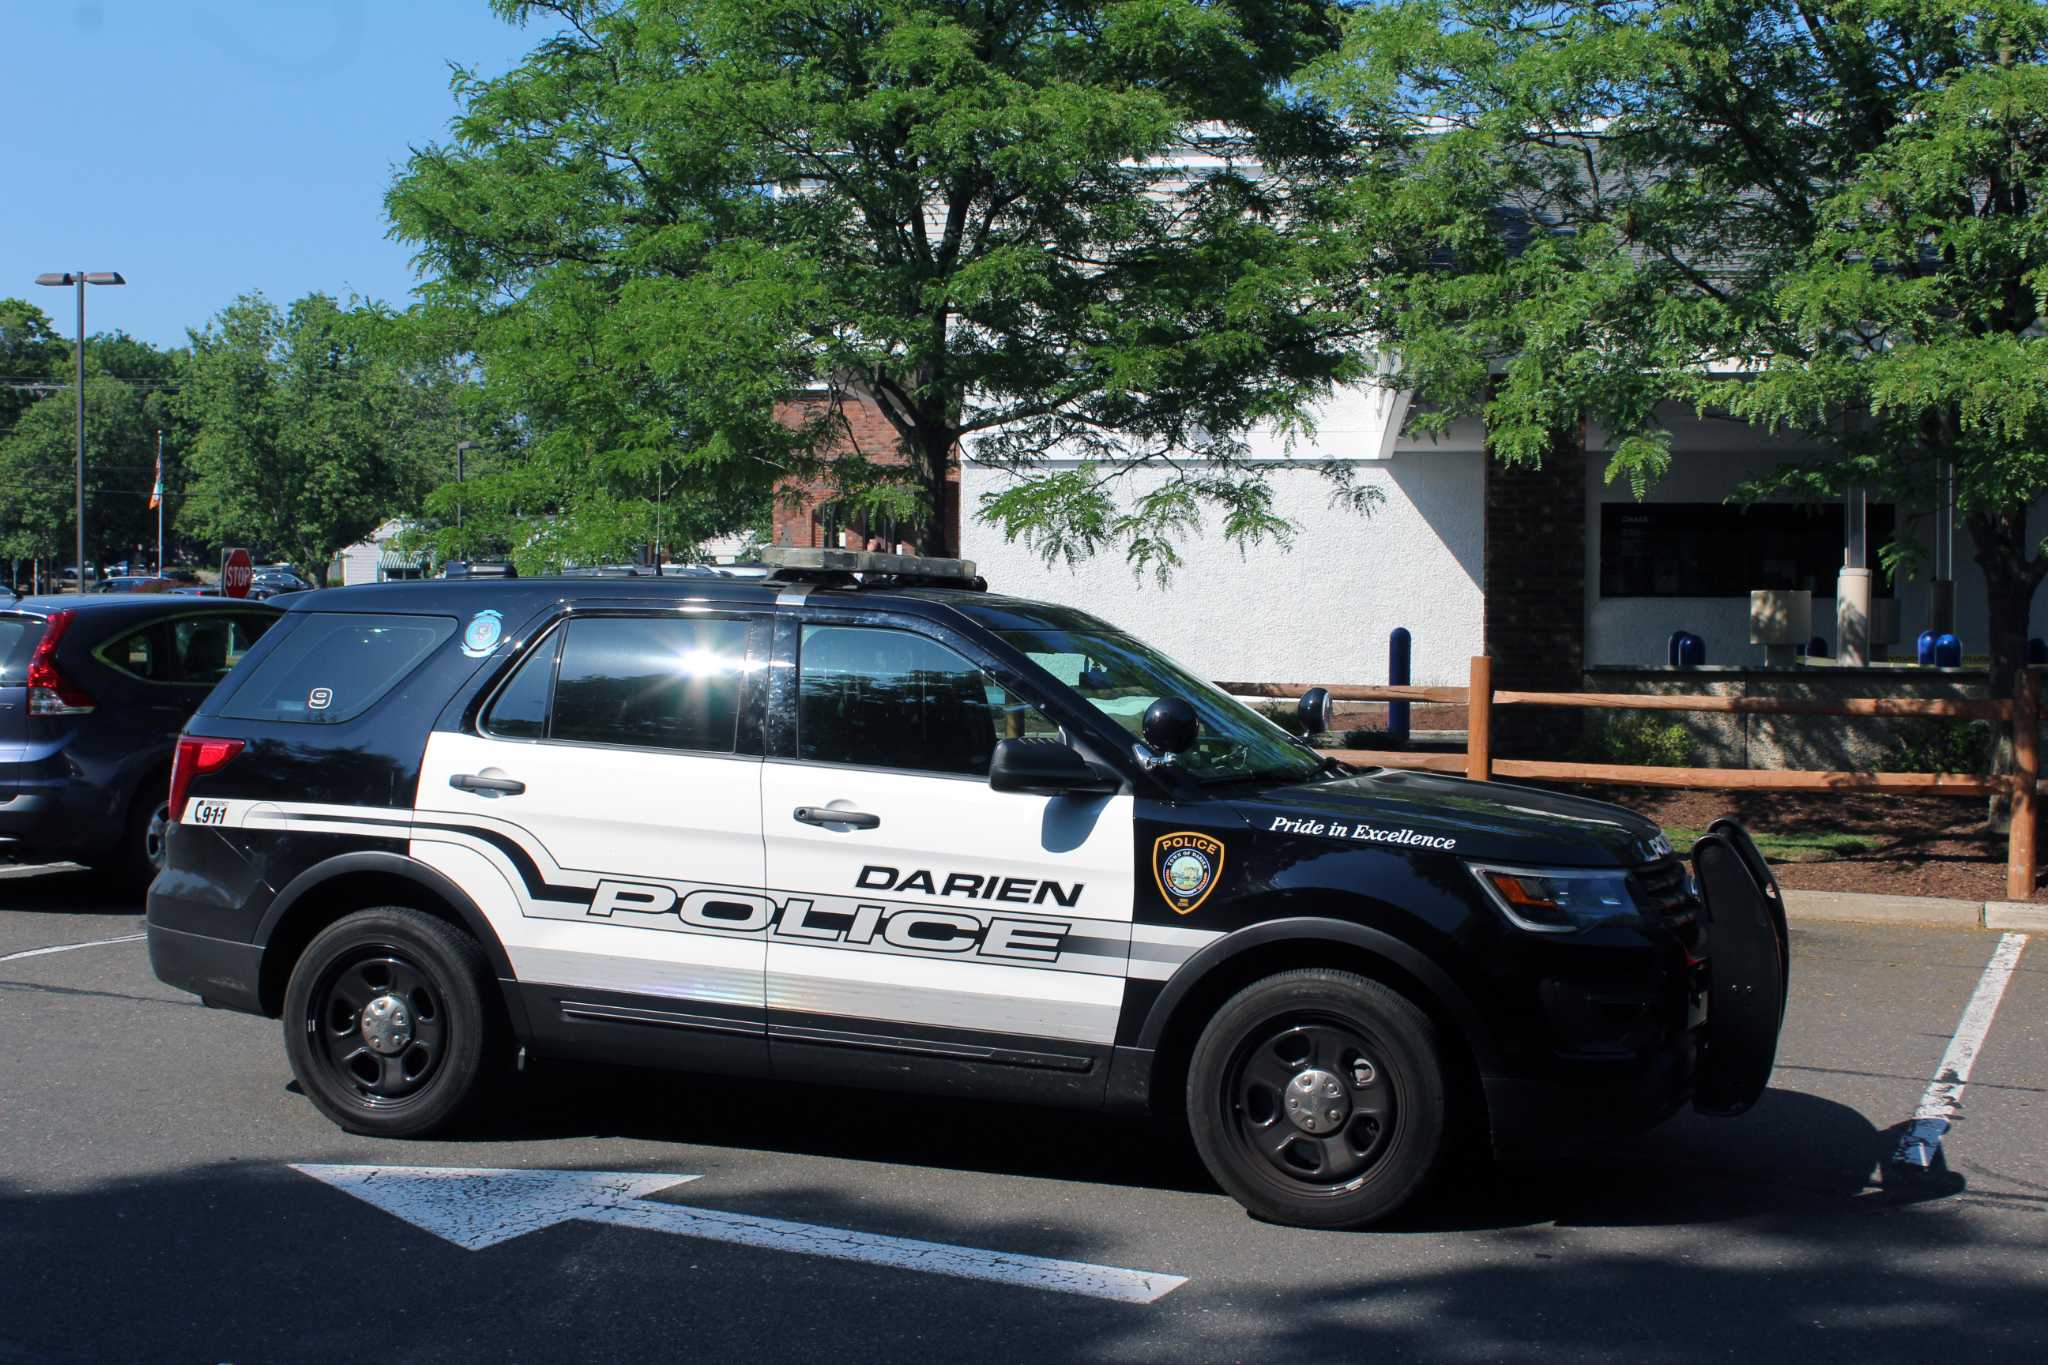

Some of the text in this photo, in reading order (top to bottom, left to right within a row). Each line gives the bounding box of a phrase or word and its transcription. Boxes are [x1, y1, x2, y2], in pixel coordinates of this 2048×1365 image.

[227, 566, 251, 587] STOP
[308, 687, 333, 709] 9
[1162, 837, 1218, 855] POLICE
[1268, 816, 1456, 850] Pride in Excellence
[855, 864, 1086, 908] DARIEN
[586, 878, 1073, 964] POLICE
